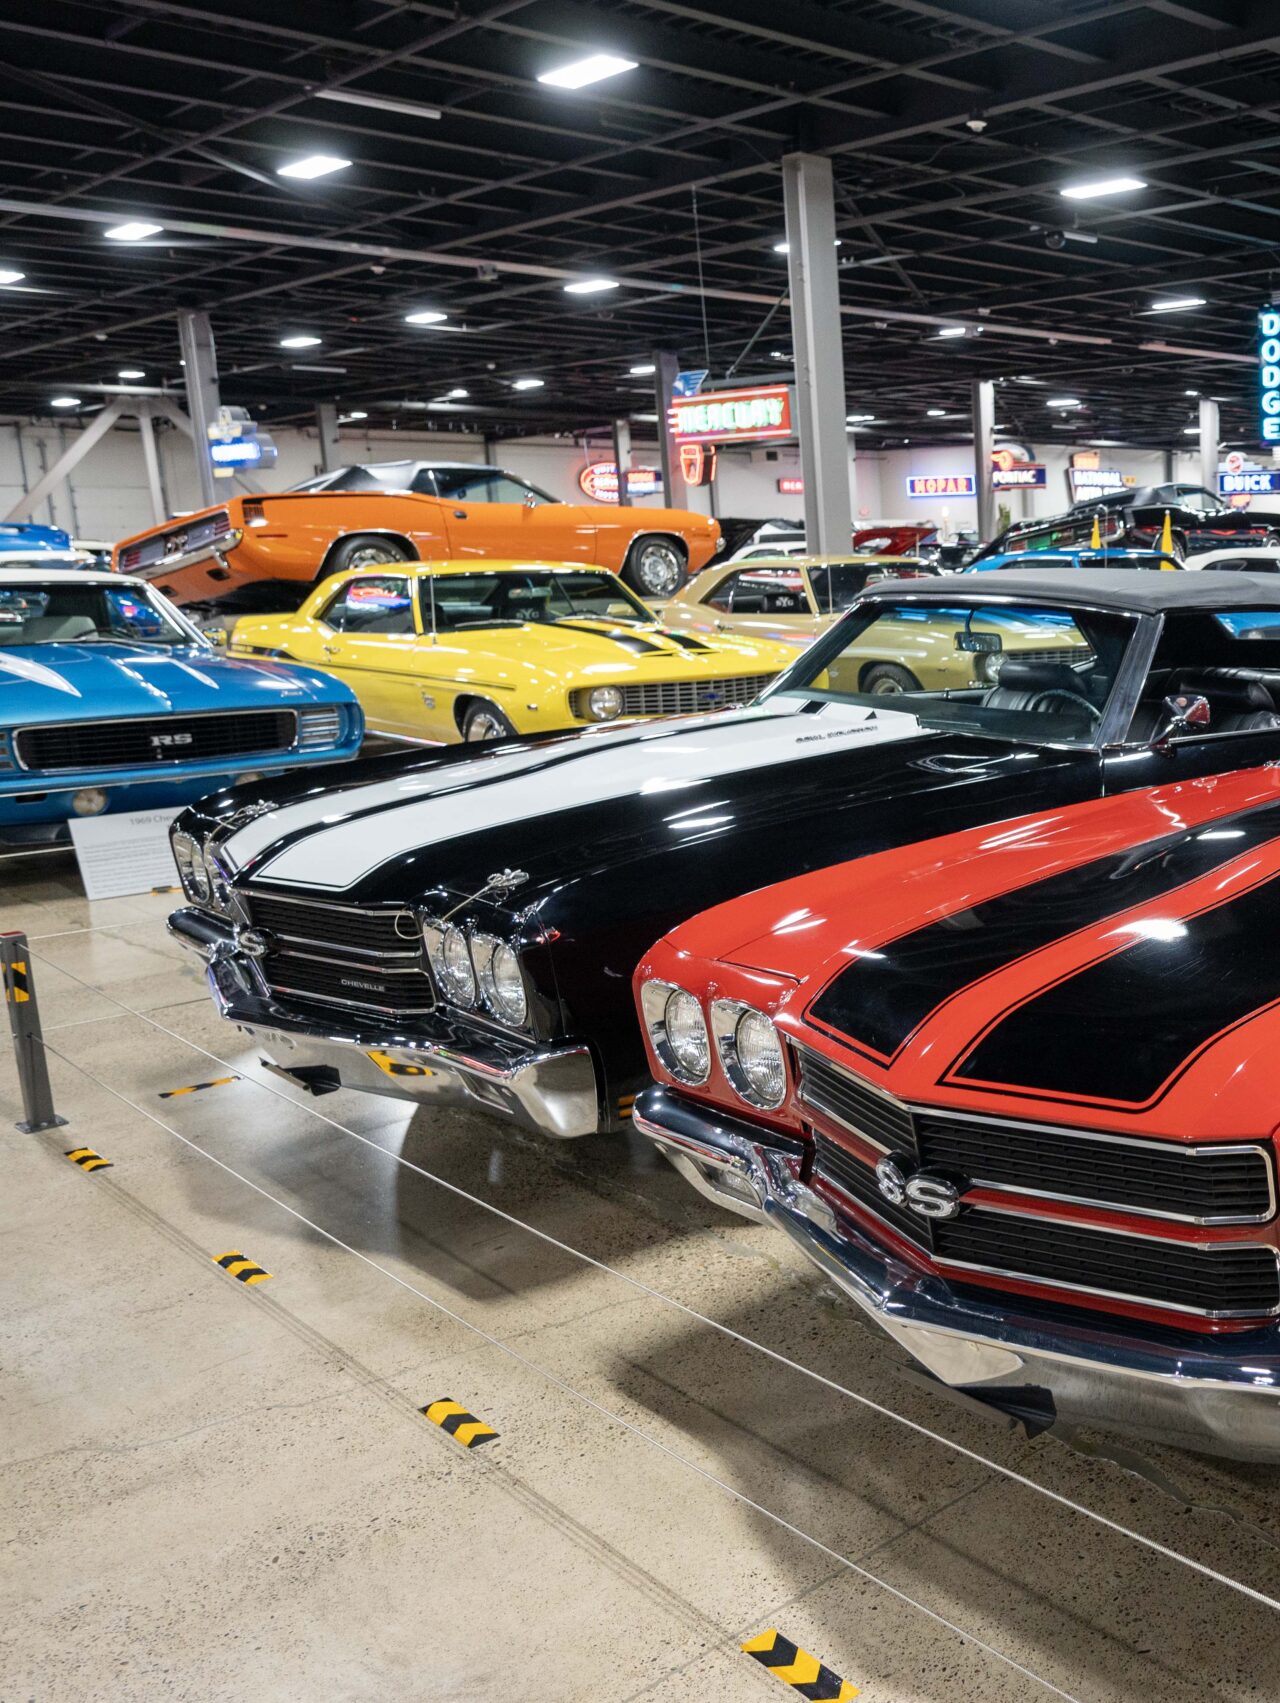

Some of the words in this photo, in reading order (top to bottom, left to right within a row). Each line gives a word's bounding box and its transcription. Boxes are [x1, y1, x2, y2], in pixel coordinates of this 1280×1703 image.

[677, 397, 785, 434] MERCURY
[914, 477, 969, 493] MOPAR
[993, 470, 1037, 485] PONTIAC
[1223, 474, 1272, 492] BUICK
[150, 733, 193, 747] RS
[341, 979, 385, 992] CHEVELLE
[876, 1159, 960, 1217] SS
